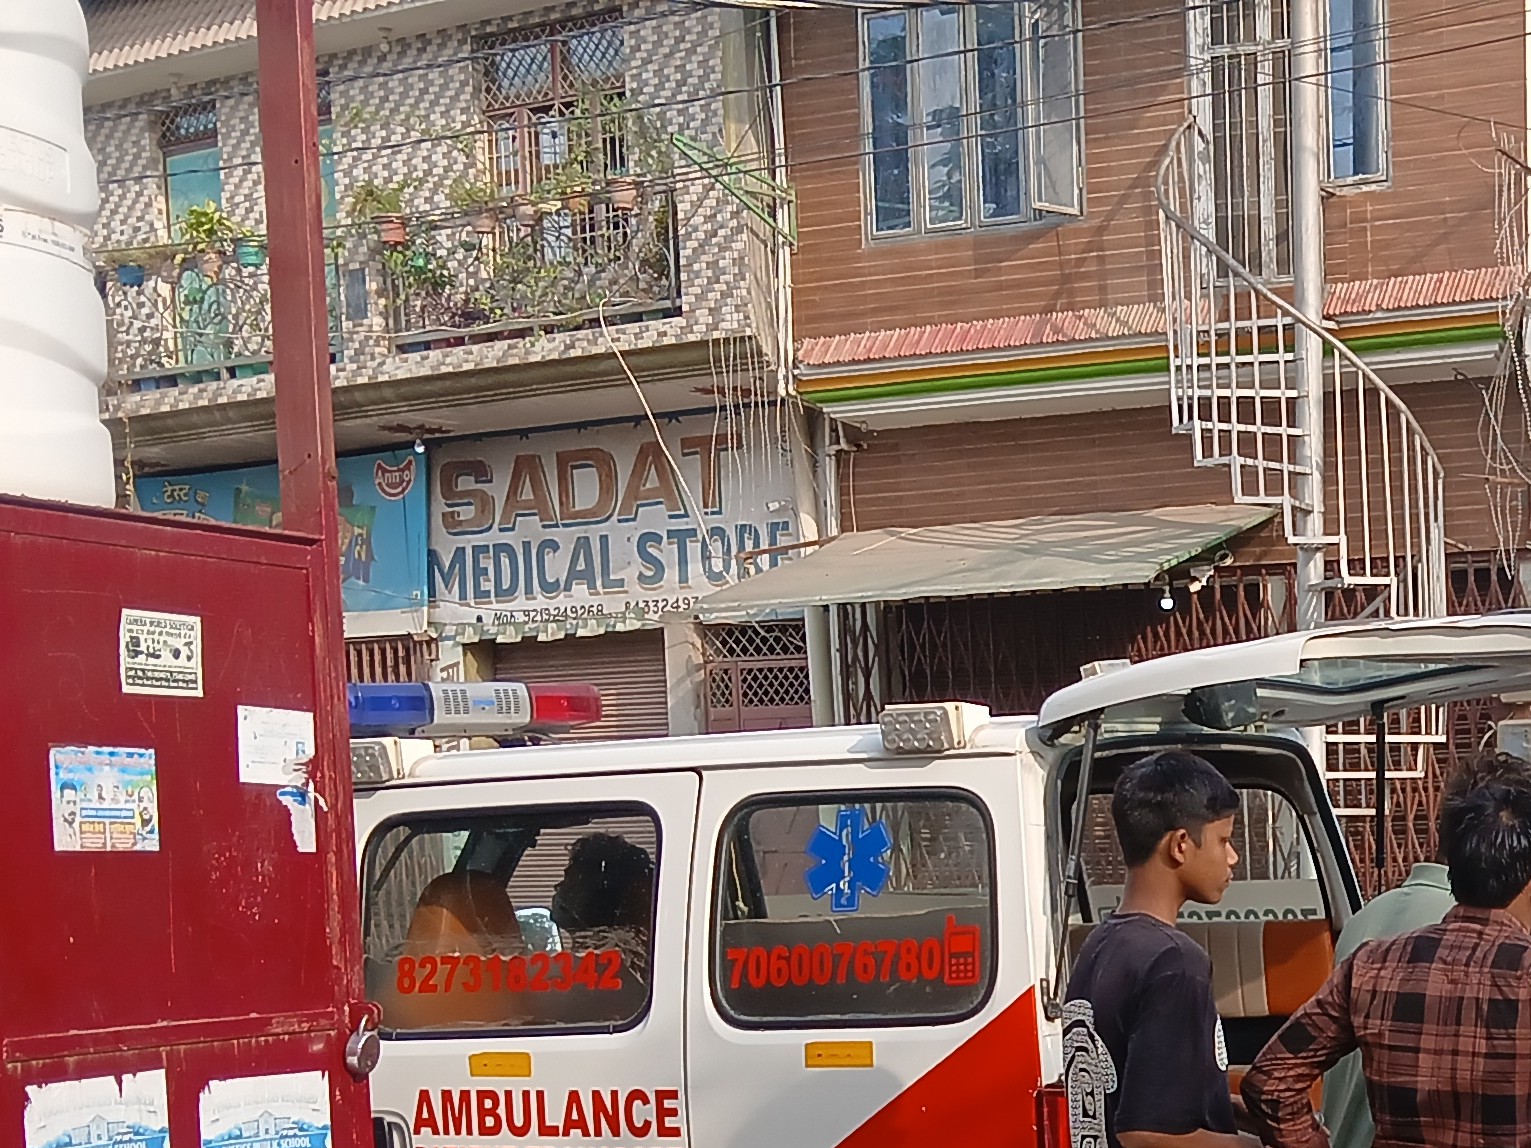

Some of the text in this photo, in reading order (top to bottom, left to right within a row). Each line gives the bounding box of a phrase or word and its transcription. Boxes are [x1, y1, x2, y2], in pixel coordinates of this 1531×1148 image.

[439, 431, 742, 536] SADAT
[428, 533, 627, 603] MEDICAL
[636, 520, 790, 588] STORE
[396, 950, 622, 995] 8273182342
[727, 936, 943, 989] 7060076780
[413, 1088, 682, 1139] AMBULANCE
